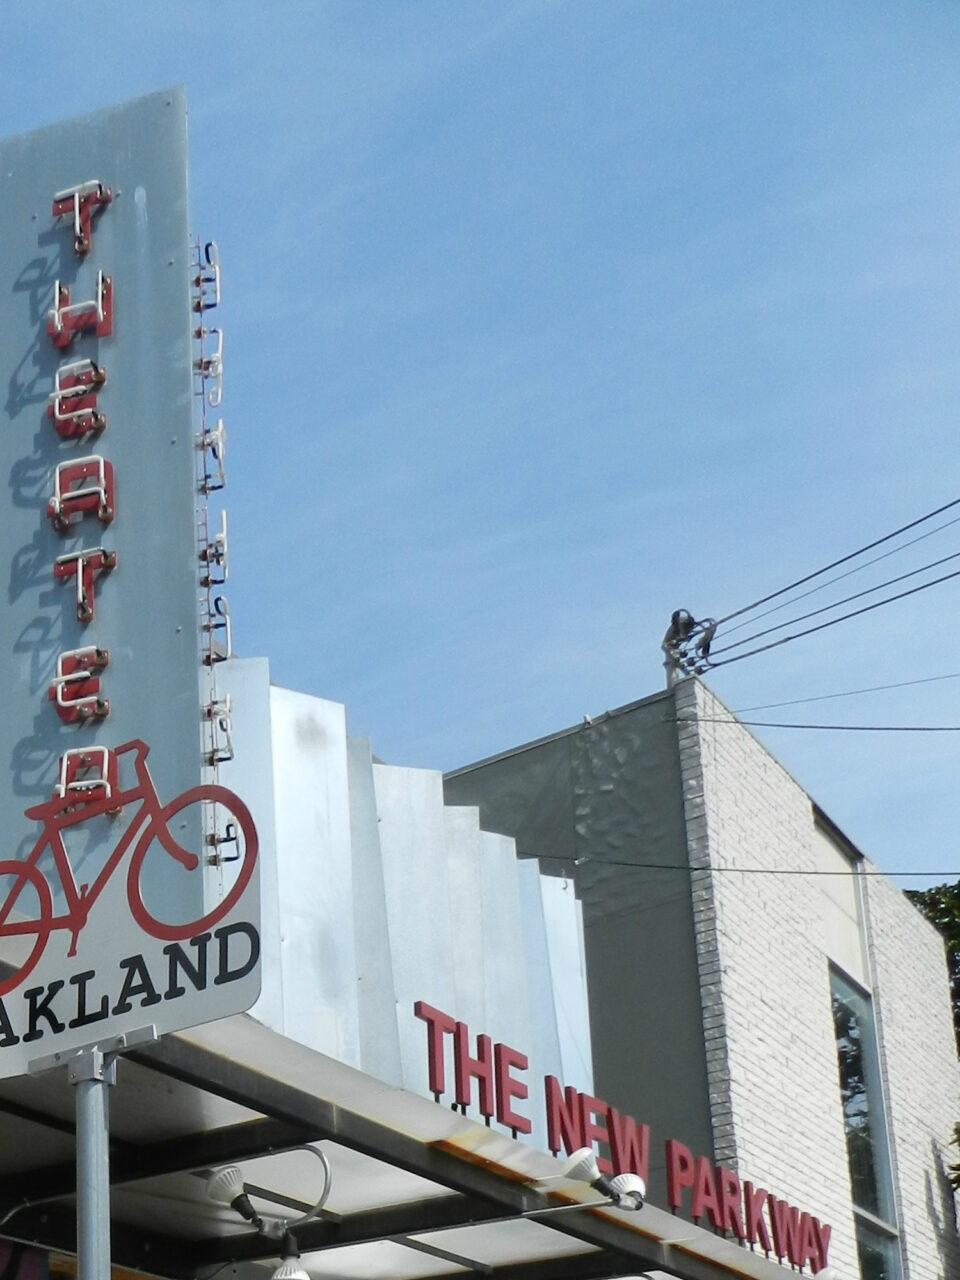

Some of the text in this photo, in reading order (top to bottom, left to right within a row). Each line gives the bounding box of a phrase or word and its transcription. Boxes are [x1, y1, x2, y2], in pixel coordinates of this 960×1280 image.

[47, 179, 117, 815] THEATER
[414, 1000, 832, 1275] THE NEW PARKWAY
